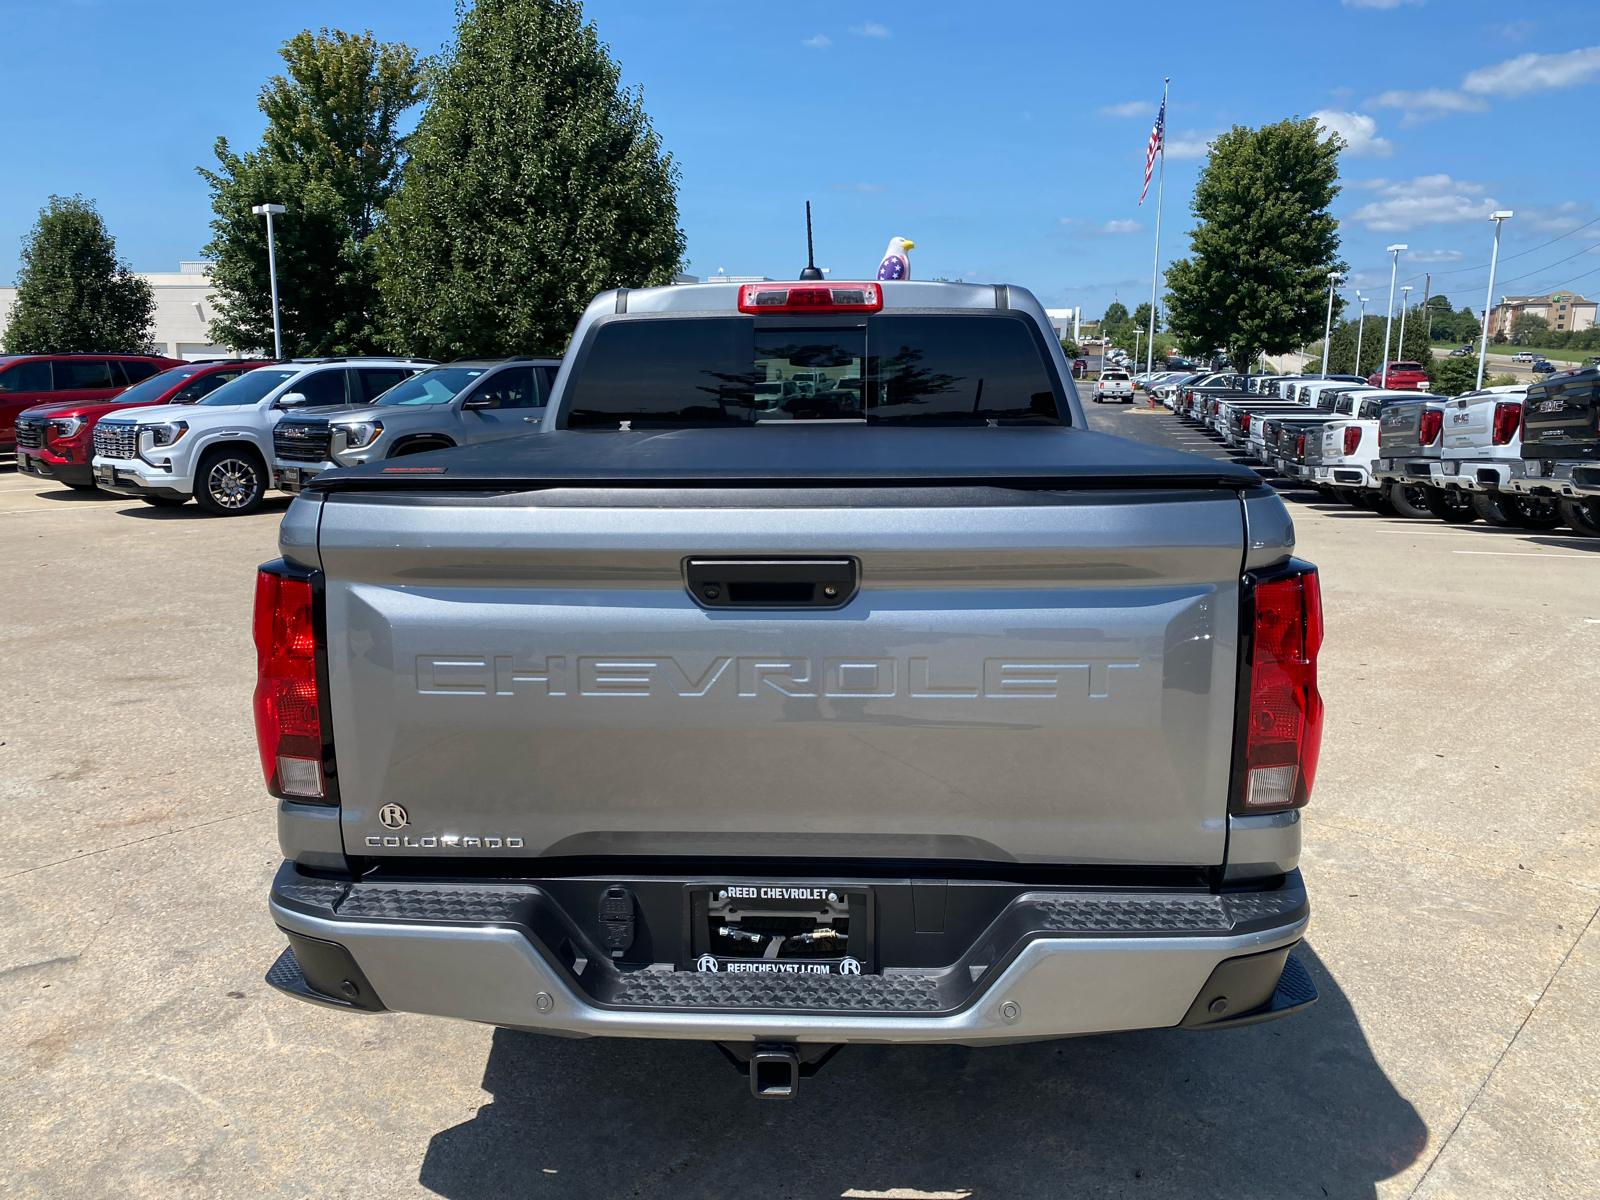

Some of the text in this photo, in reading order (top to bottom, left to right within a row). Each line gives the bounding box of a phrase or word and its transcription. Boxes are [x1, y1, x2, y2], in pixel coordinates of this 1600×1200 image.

[415, 654, 1140, 699] CHEVROLET
[364, 836, 525, 849] COLORADO
[727, 886, 828, 900] REED CHEVROLET
